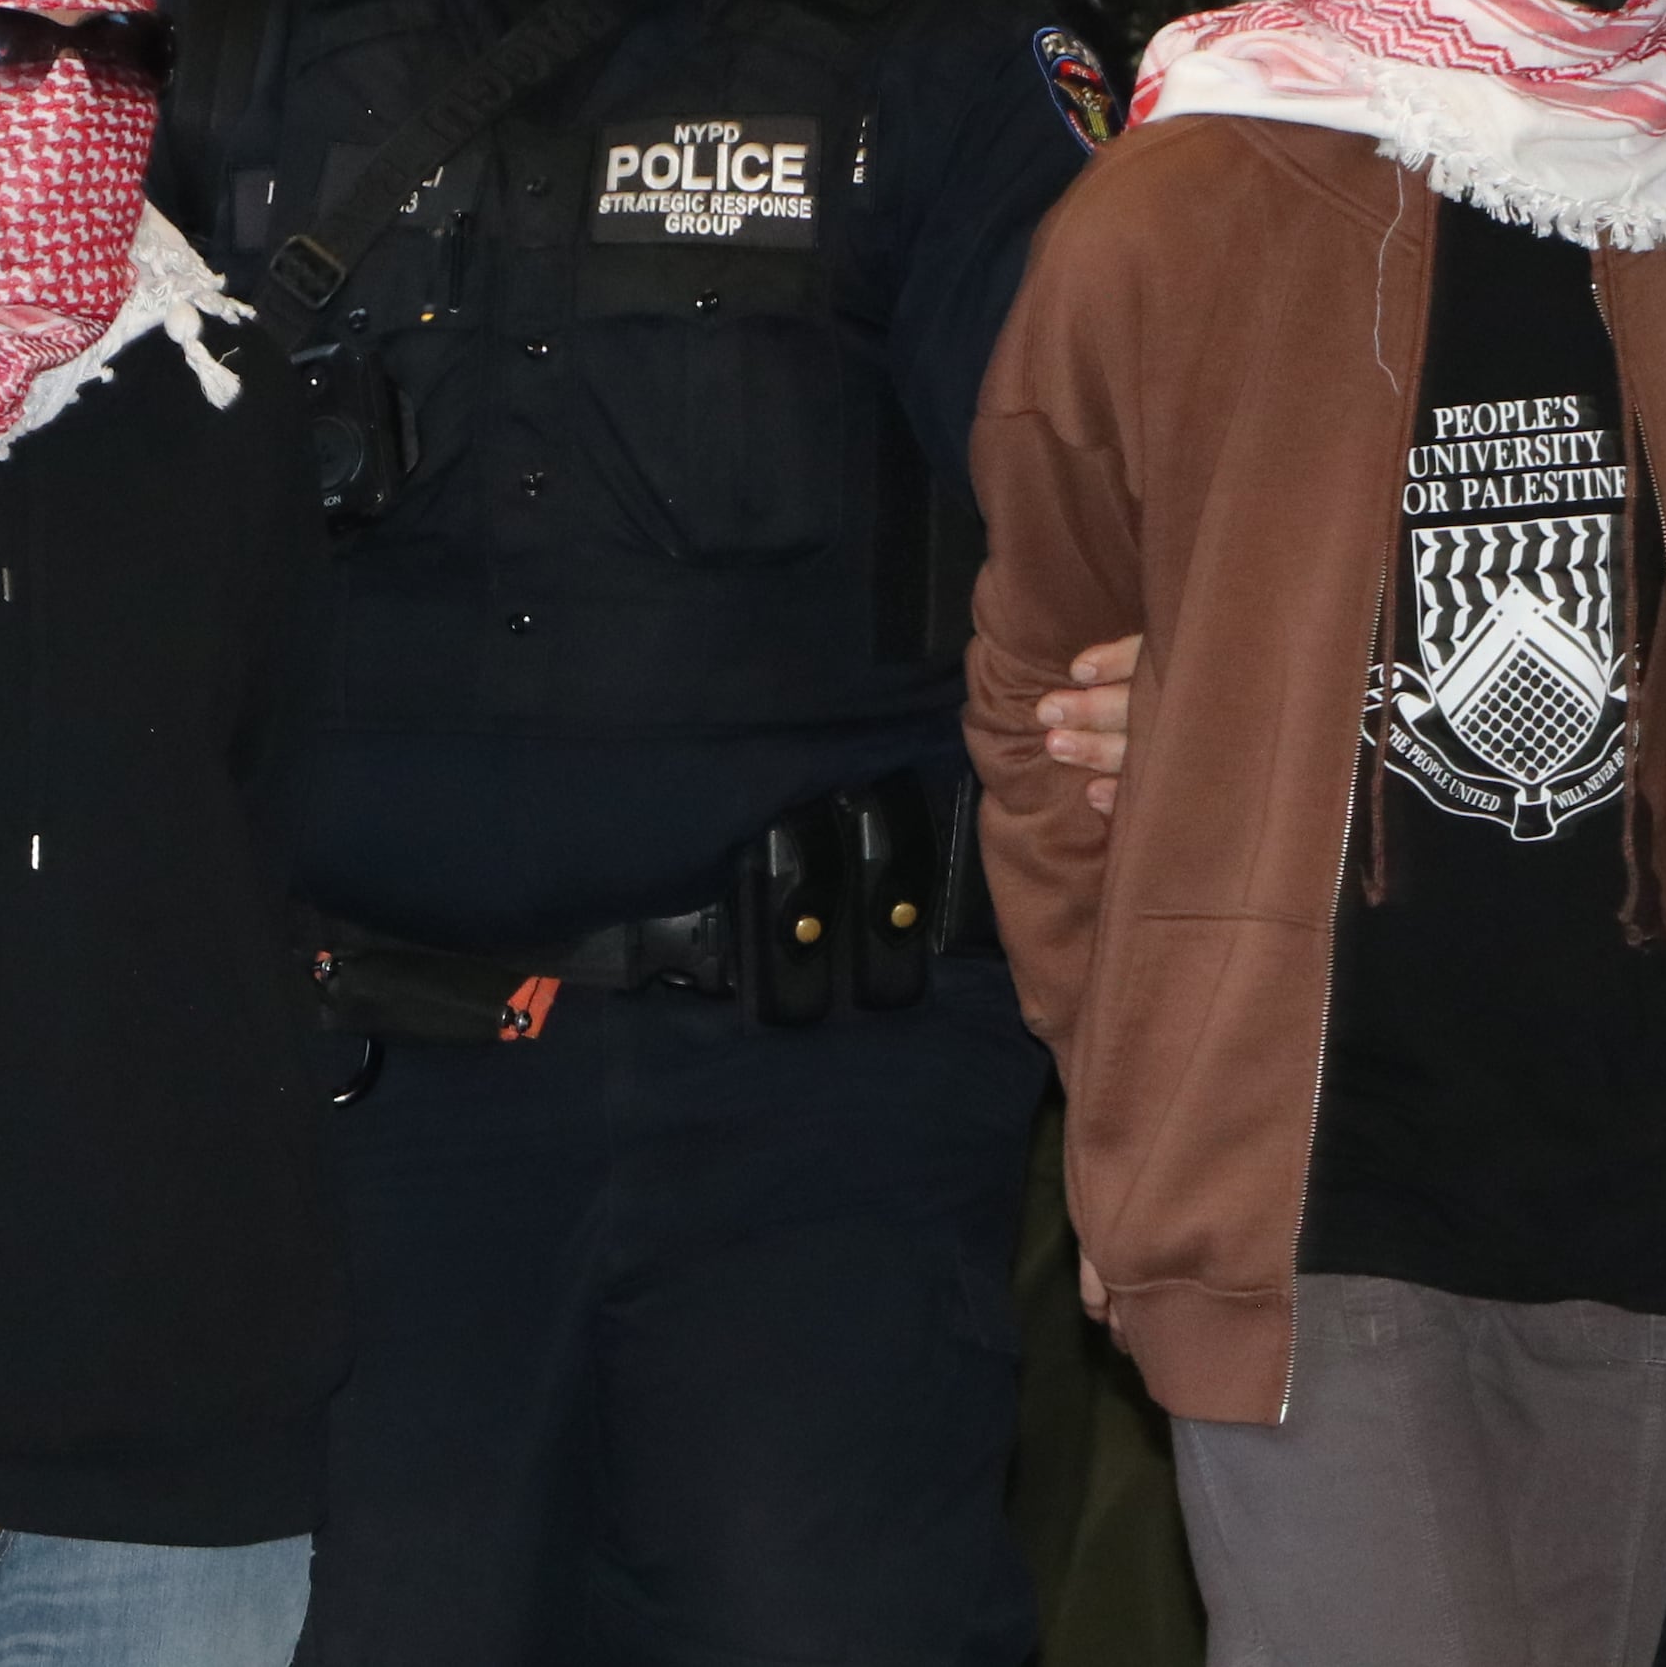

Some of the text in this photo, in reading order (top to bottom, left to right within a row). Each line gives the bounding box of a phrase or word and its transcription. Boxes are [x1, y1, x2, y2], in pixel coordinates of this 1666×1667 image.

[673, 120, 741, 145] NYPD
[605, 141, 809, 195] POLICE
[598, 192, 813, 219] STRATEGIC RESPONSE
[664, 213, 743, 236] GROUP
[1432, 394, 1581, 440] PEOPLE'S
[1407, 429, 1605, 479] UNIVERSITY
[1401, 465, 1627, 515] OR PALESTINE
[1404, 743, 1451, 789] PEOPLE
[1448, 778, 1502, 812] UNITED
[1553, 784, 1587, 810] WILL
[1583, 759, 1619, 793] NEVER
